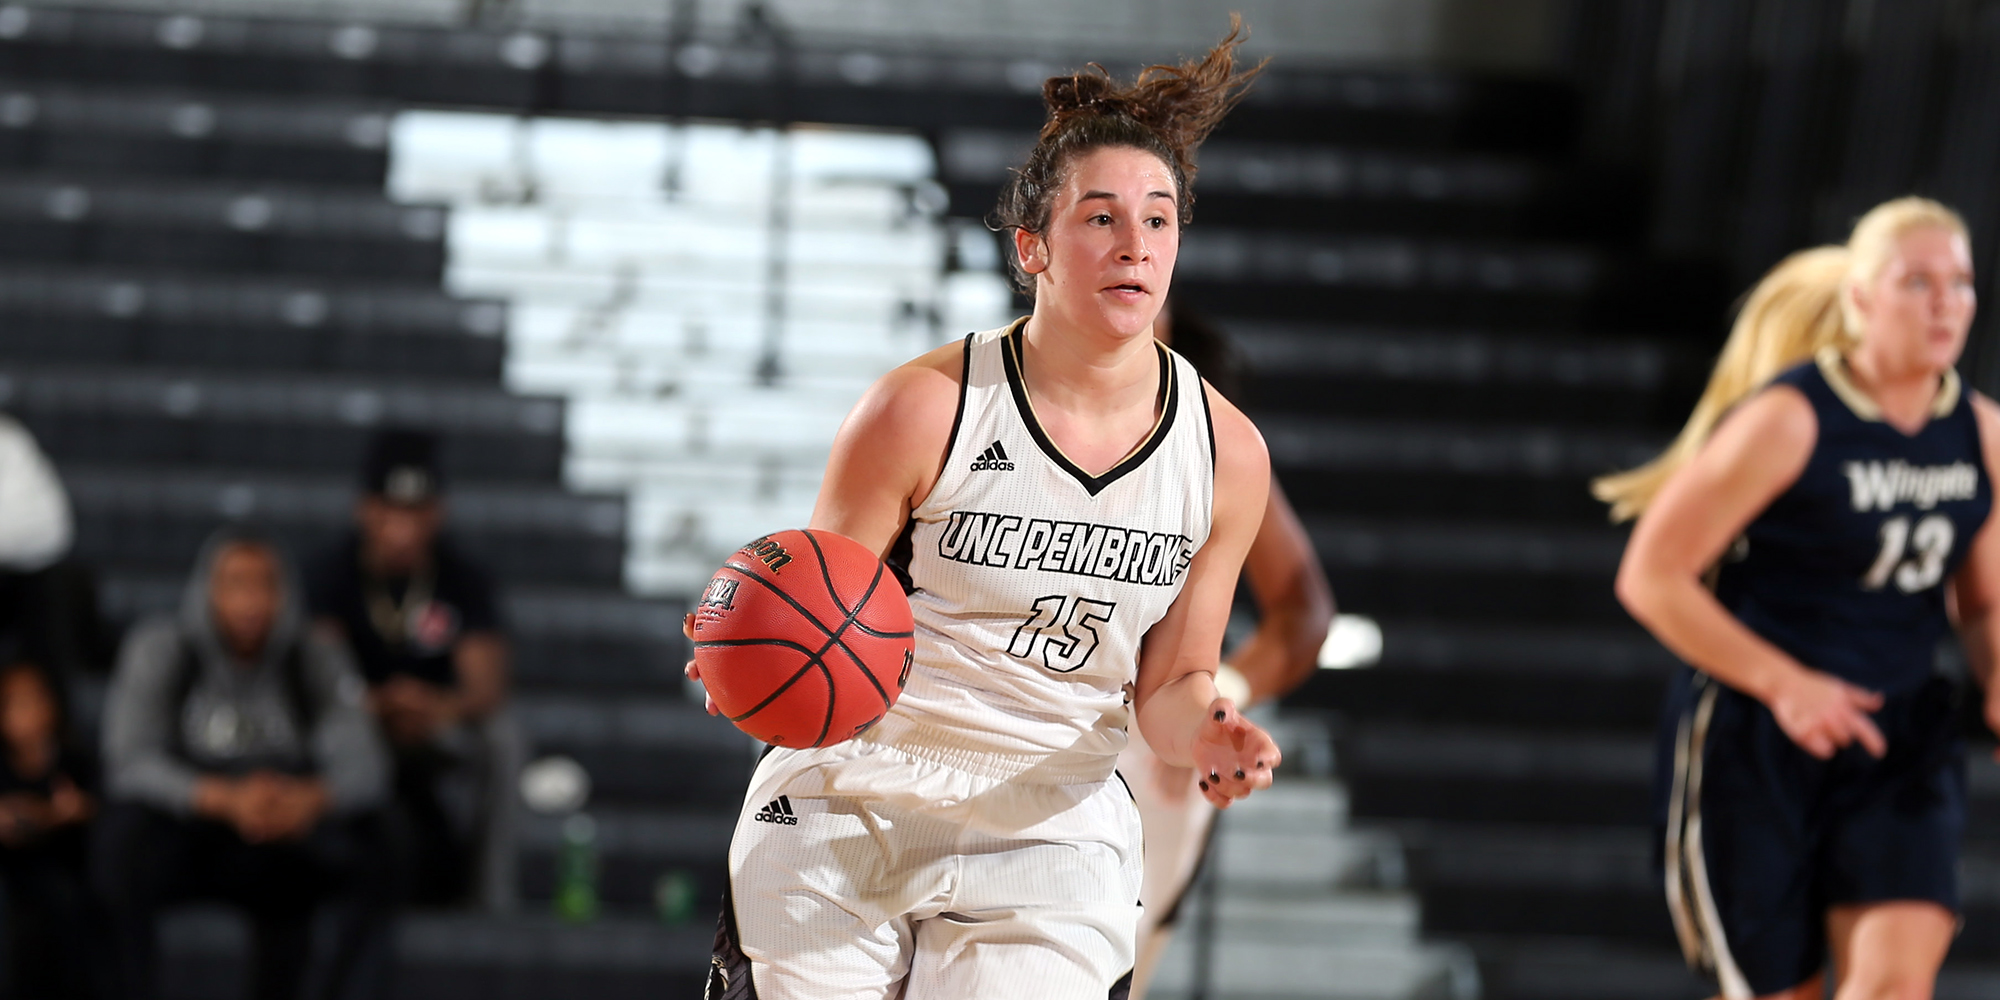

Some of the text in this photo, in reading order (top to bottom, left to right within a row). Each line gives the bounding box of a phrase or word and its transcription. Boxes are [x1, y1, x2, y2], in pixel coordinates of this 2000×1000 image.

[970, 458, 1015, 472] adidas
[1843, 459, 1979, 512] Wingate
[938, 511, 1023, 568] UNC
[1862, 515, 1956, 593] 13
[1006, 594, 1117, 673] 15
[754, 811, 798, 826] adidas
